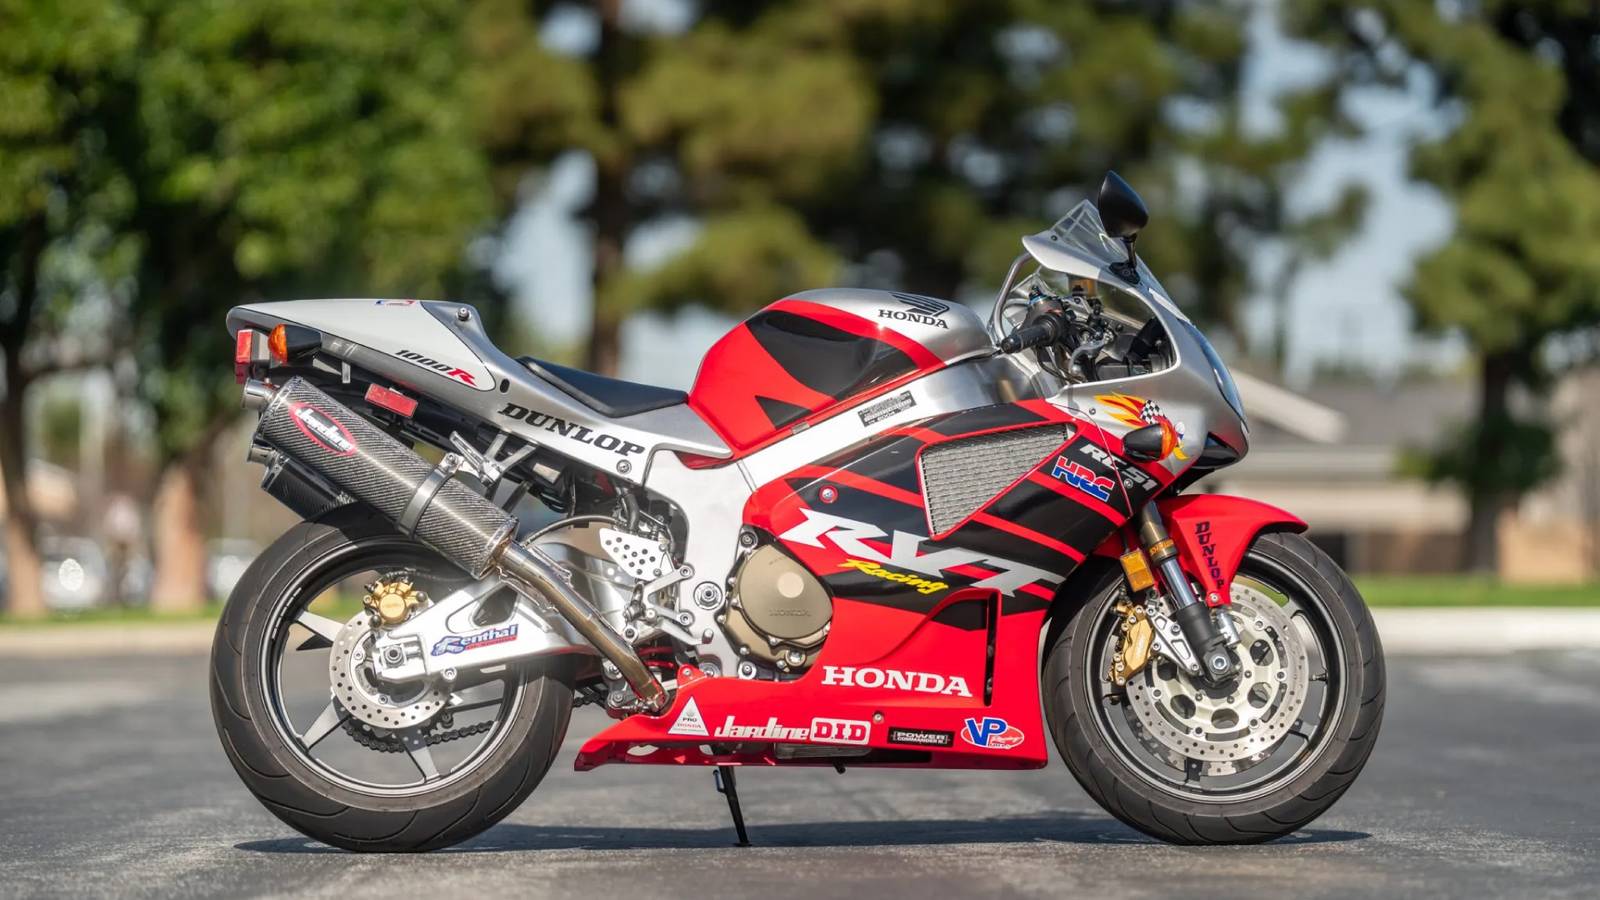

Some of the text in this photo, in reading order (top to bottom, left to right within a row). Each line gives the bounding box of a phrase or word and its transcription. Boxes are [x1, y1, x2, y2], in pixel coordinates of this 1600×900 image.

[878, 309, 949, 329] HONDA
[394, 349, 478, 387] 1000R
[497, 402, 646, 456] DUNLOP
[1051, 455, 1116, 502] HRC
[779, 507, 1067, 597] RVT
[1195, 521, 1225, 589] DUNLOP
[837, 558, 949, 594] Racing
[430, 623, 519, 656] Renthal
[821, 665, 973, 698] HONDA
[714, 715, 811, 740] Jardine
[896, 732, 945, 740] POWER
[964, 716, 1008, 748] VP
